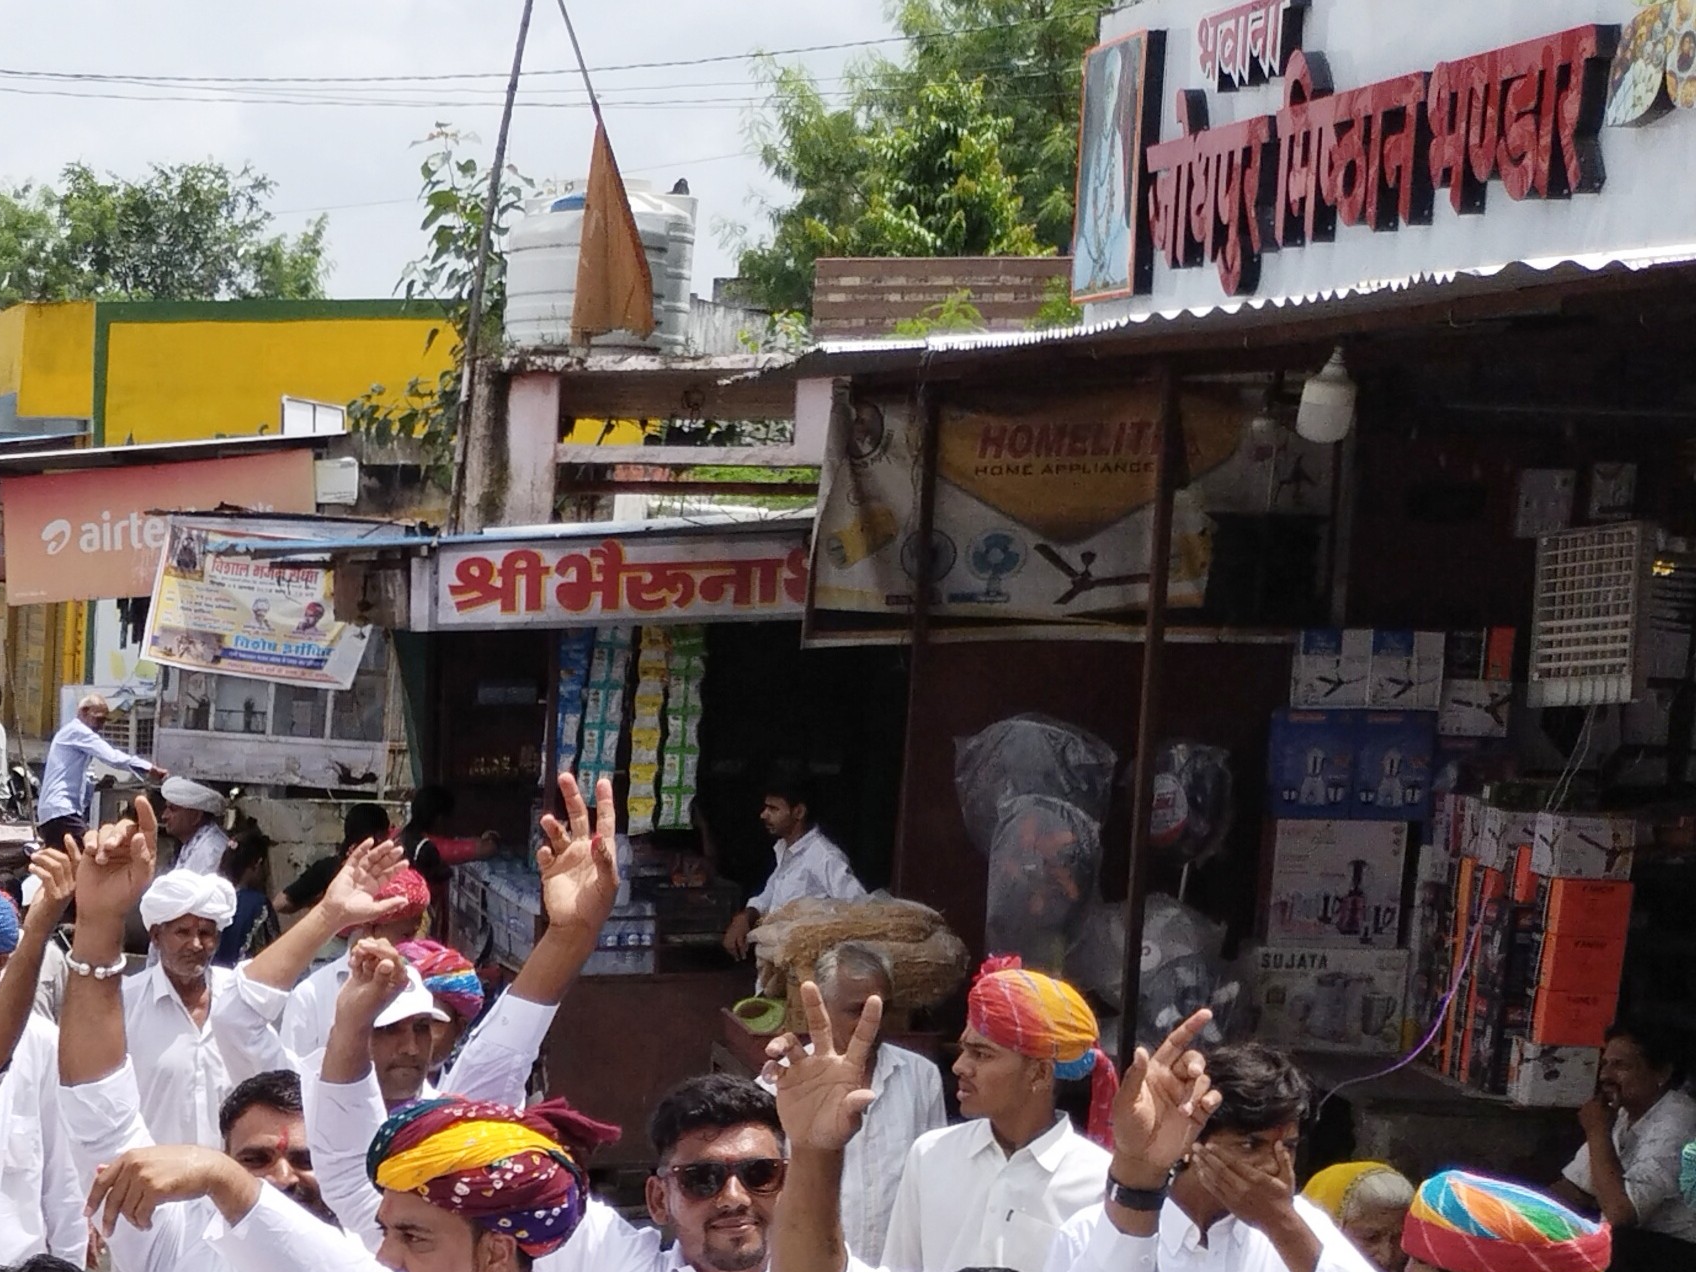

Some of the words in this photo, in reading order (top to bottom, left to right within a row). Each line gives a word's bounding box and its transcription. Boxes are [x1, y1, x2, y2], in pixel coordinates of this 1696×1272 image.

[1148, 89, 1274, 297] जोधपुर
[1274, 49, 1428, 243] मिष्ठान
[1428, 24, 1600, 215] भण्डार
[974, 463, 1034, 477] HOME
[79, 510, 167, 553] airte
[448, 547, 552, 616] श्री
[1260, 951, 1328, 969] SUJATA
